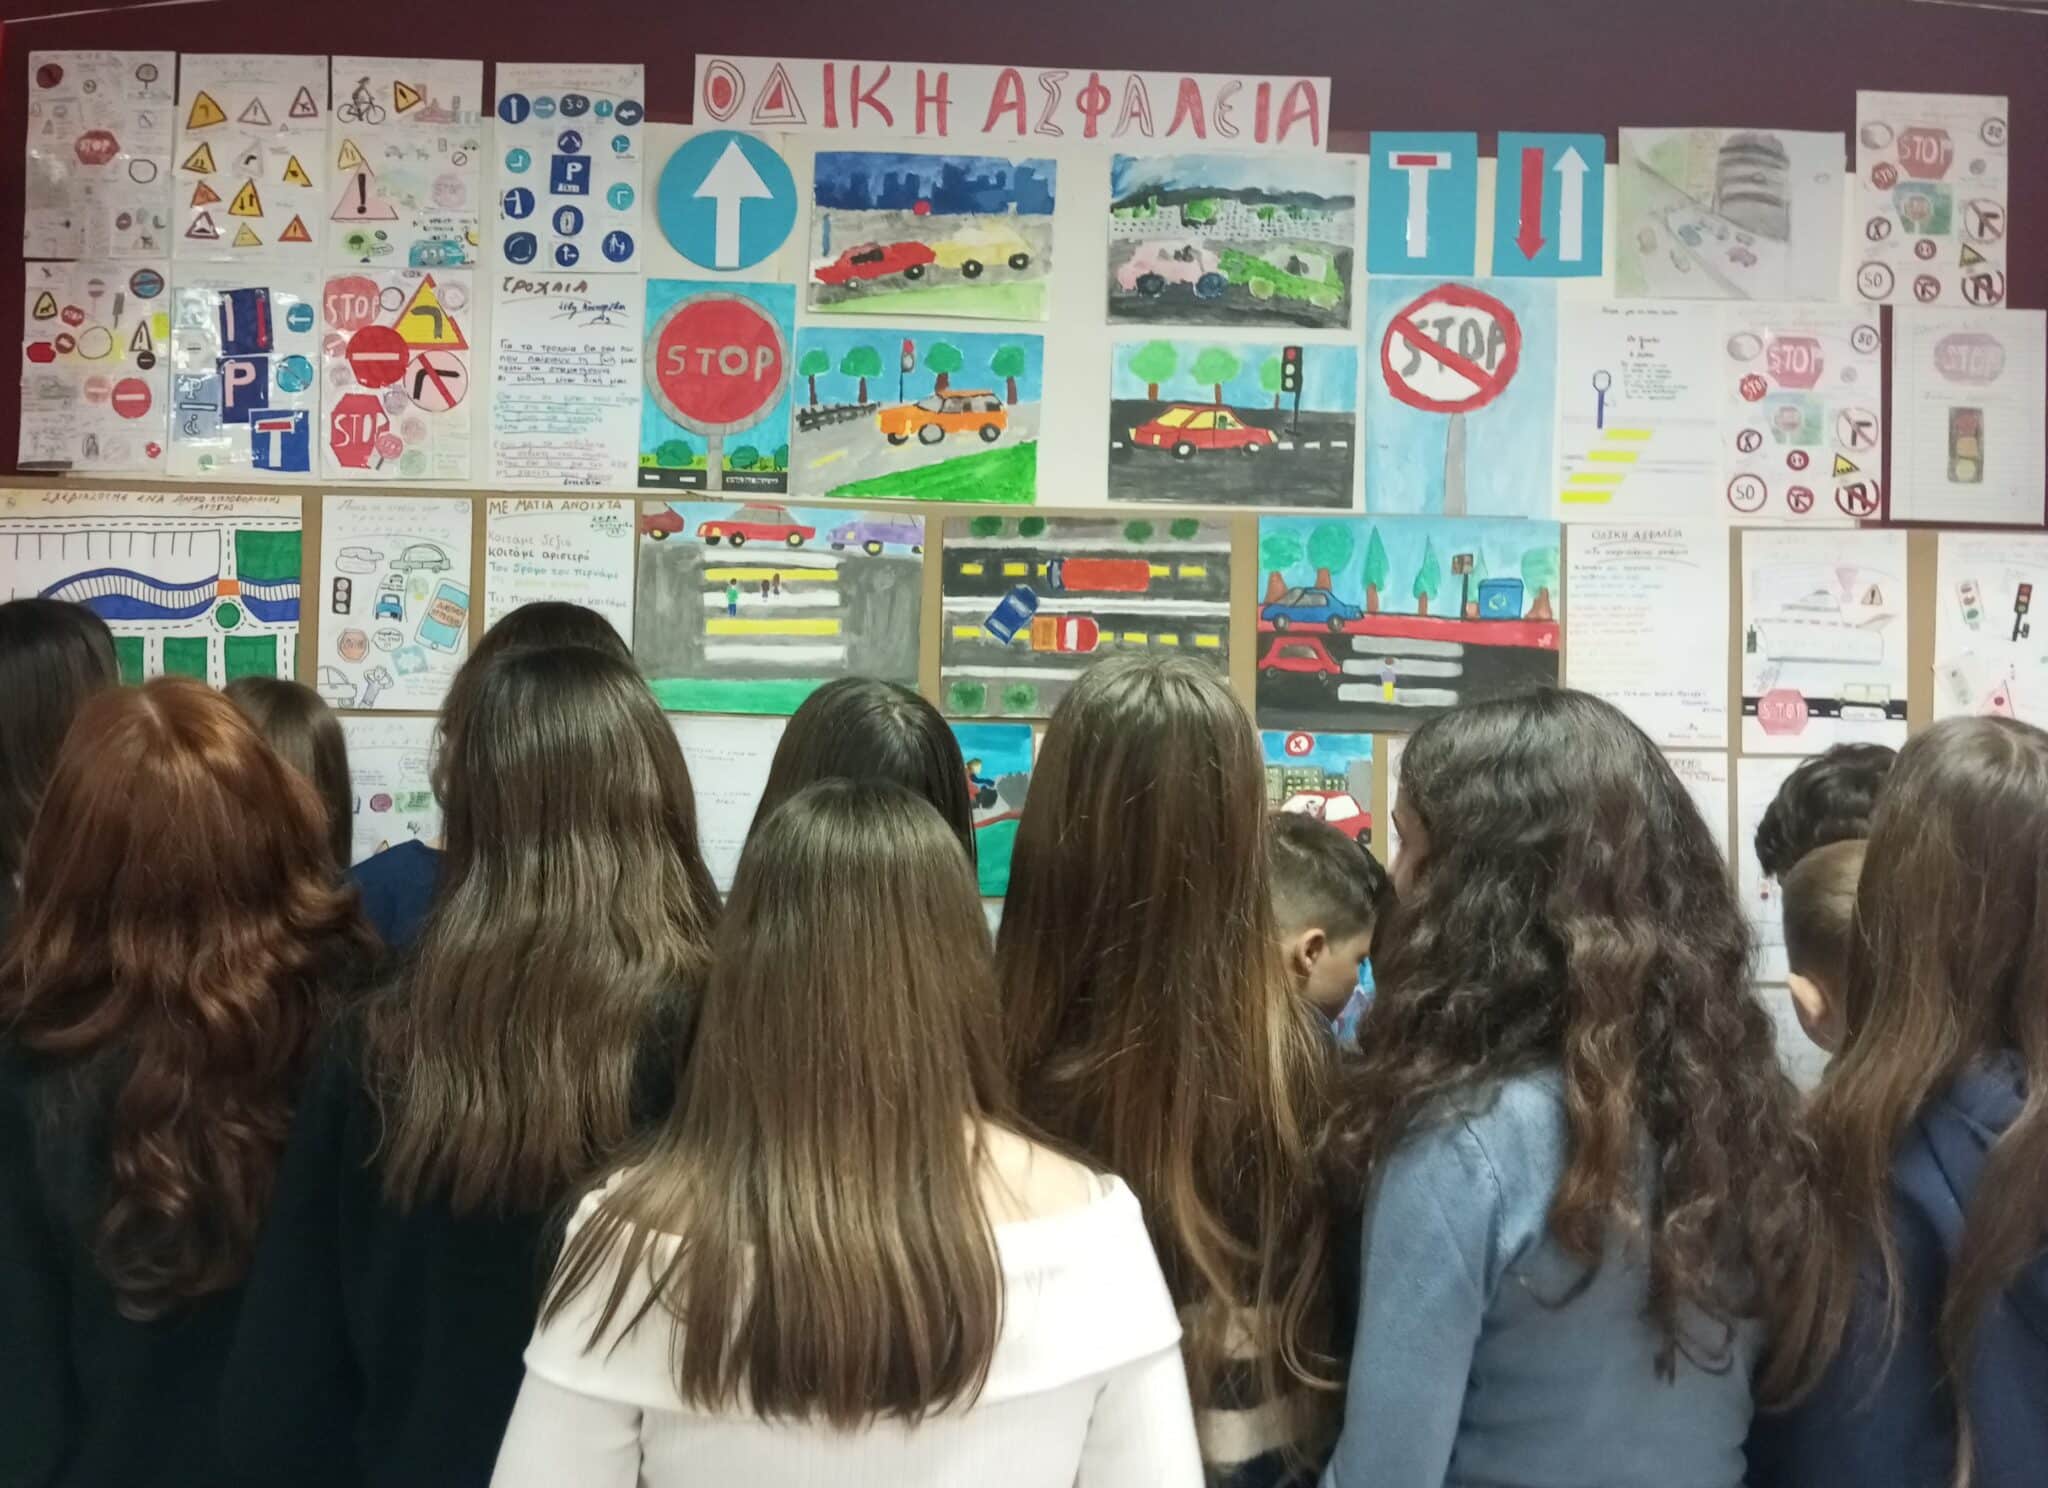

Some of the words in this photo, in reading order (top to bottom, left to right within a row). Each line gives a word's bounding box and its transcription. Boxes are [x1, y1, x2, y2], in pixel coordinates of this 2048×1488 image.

[704, 59, 949, 137] ΟΔΙΚΗ
[981, 67, 1320, 146] ΑΣΦΑΛΕΙΑ
[1864, 272, 1883, 289] 50
[326, 293, 379, 324] STOP
[1857, 333, 1873, 346] 50
[664, 344, 775, 383] STOP
[225, 360, 257, 408] P
[334, 412, 387, 448] STOP
[488, 500, 509, 515] ΜΕ
[514, 499, 554, 512] ΜΑΤΙΑ
[560, 499, 623, 512] ΑΝΟΙΧΤΑ
[1735, 484, 1755, 500] 50
